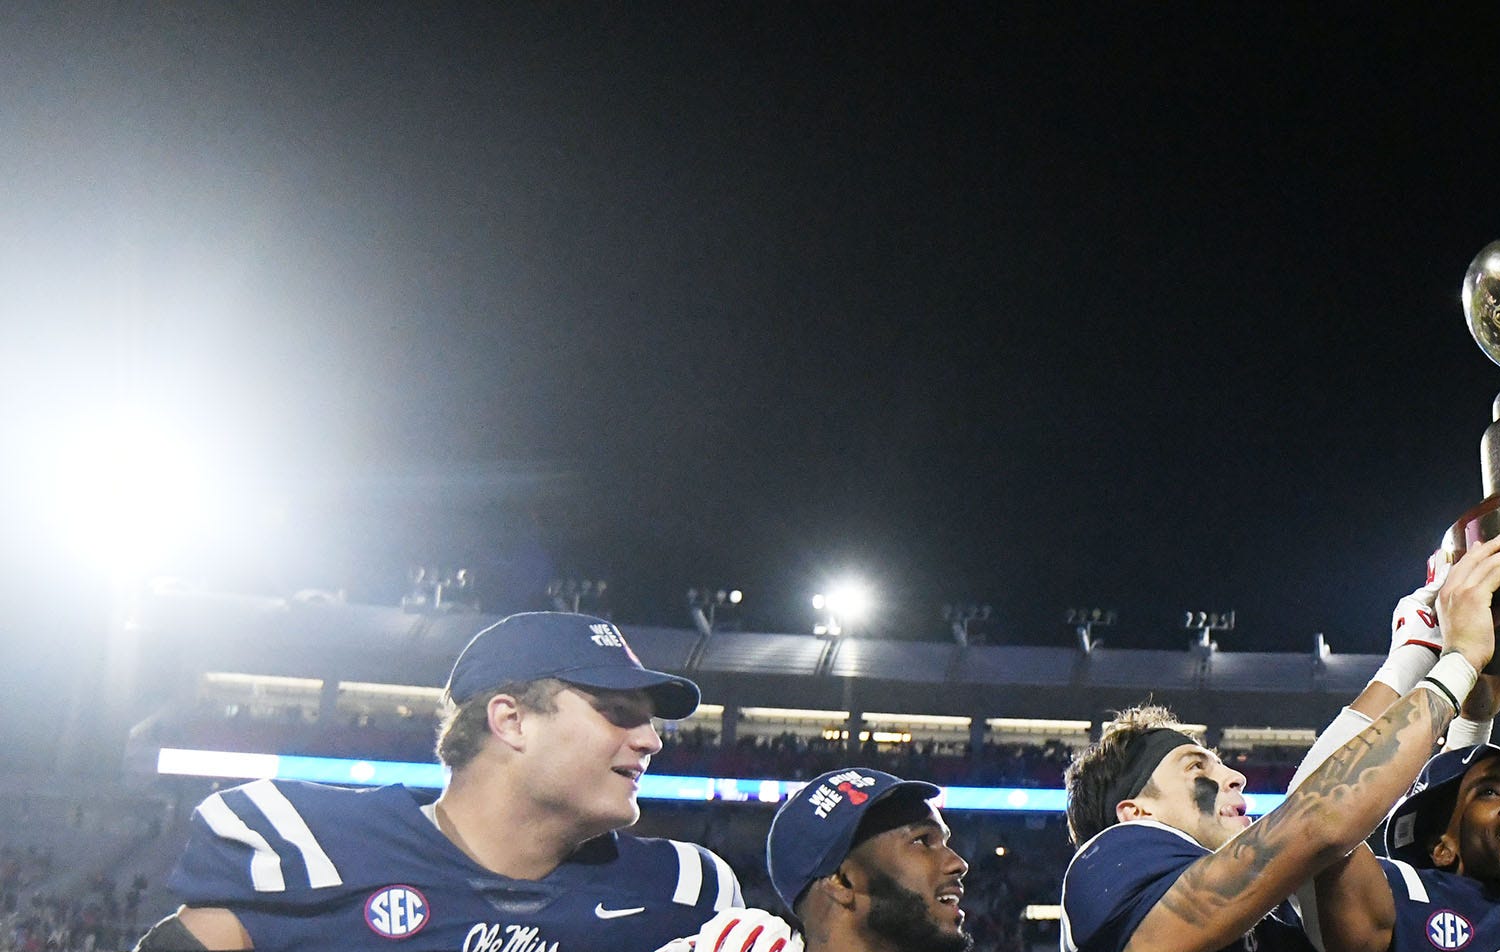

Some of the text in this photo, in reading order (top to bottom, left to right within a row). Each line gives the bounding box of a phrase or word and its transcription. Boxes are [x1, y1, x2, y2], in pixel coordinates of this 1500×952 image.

[589, 623, 612, 637] WE
[591, 634, 622, 648] THE
[808, 782, 831, 806] WE
[814, 789, 843, 820] THE
[369, 887, 427, 935] SEC
[1429, 911, 1472, 949] SEC
